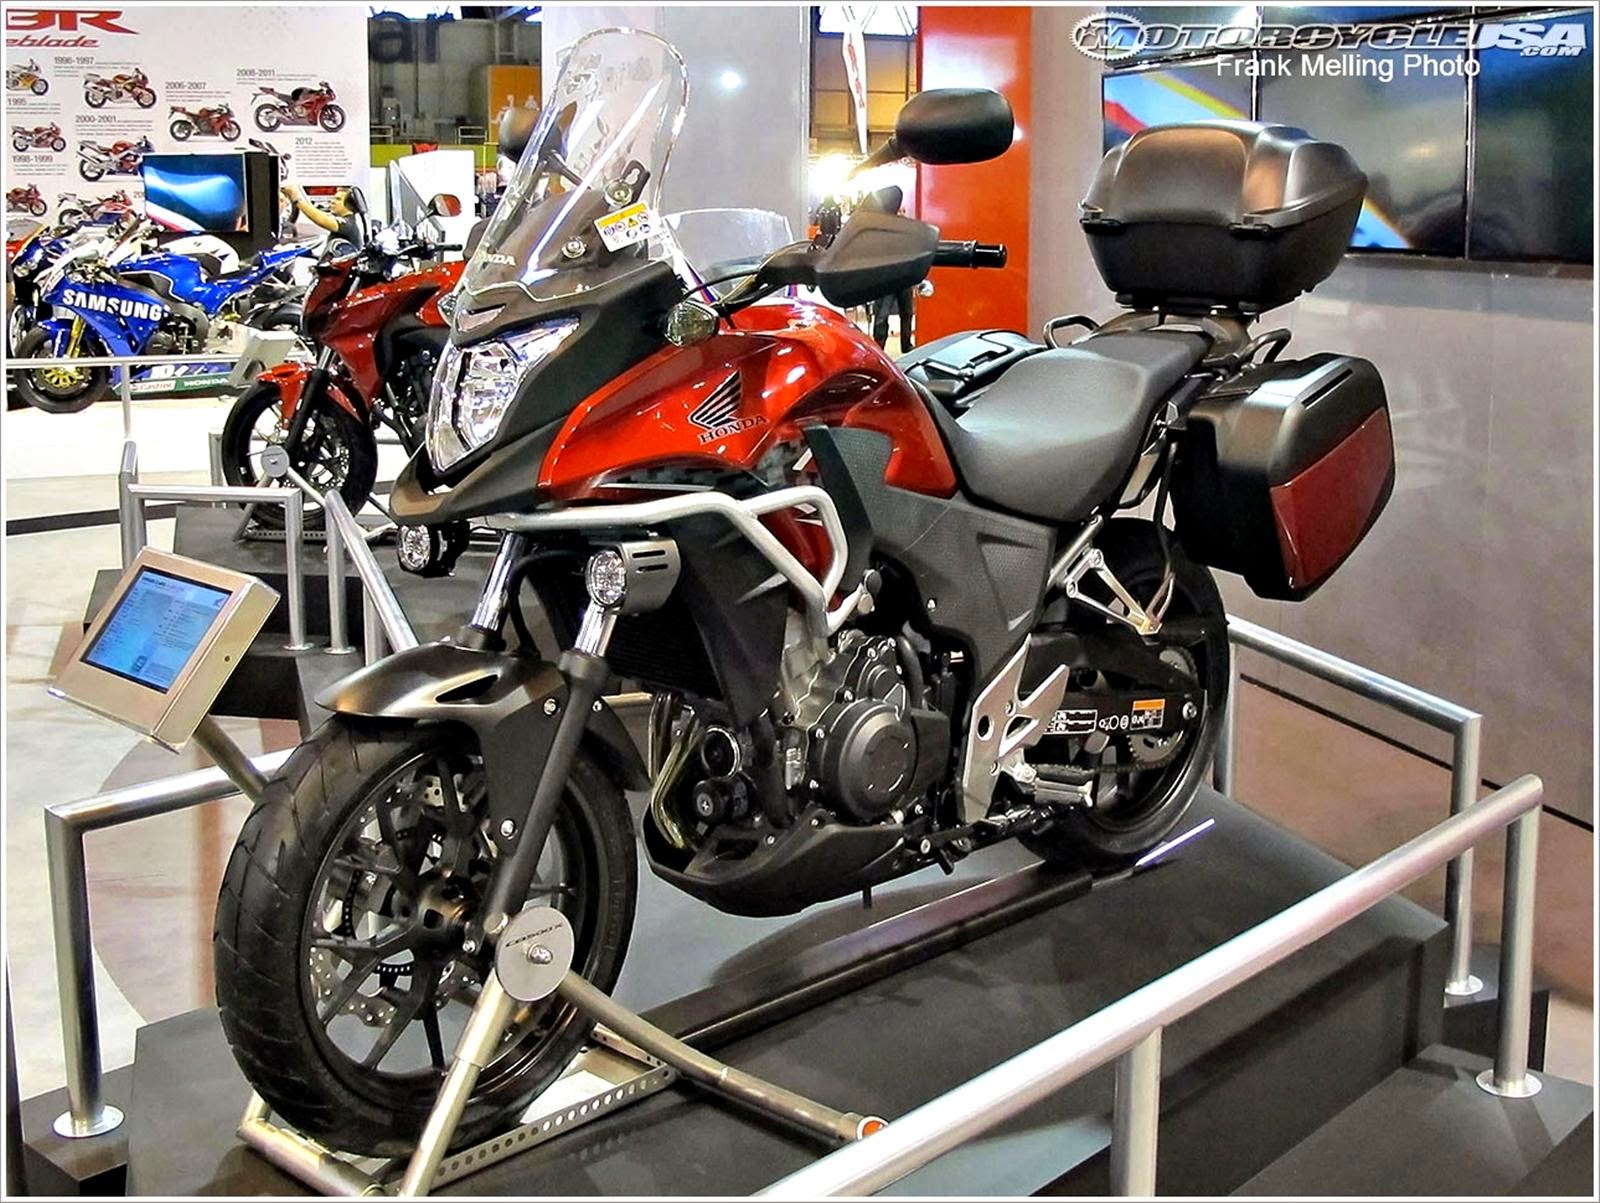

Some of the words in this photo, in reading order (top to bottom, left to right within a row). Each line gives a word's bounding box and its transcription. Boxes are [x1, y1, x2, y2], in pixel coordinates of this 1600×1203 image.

[236, 68, 276, 77] 2008-2011
[165, 81, 207, 90] 2006-2007
[75, 115, 117, 123] 2000-2001
[295, 137, 313, 145] 2012
[62, 288, 163, 322] SAMSUNG
[699, 414, 767, 444] HONDA
